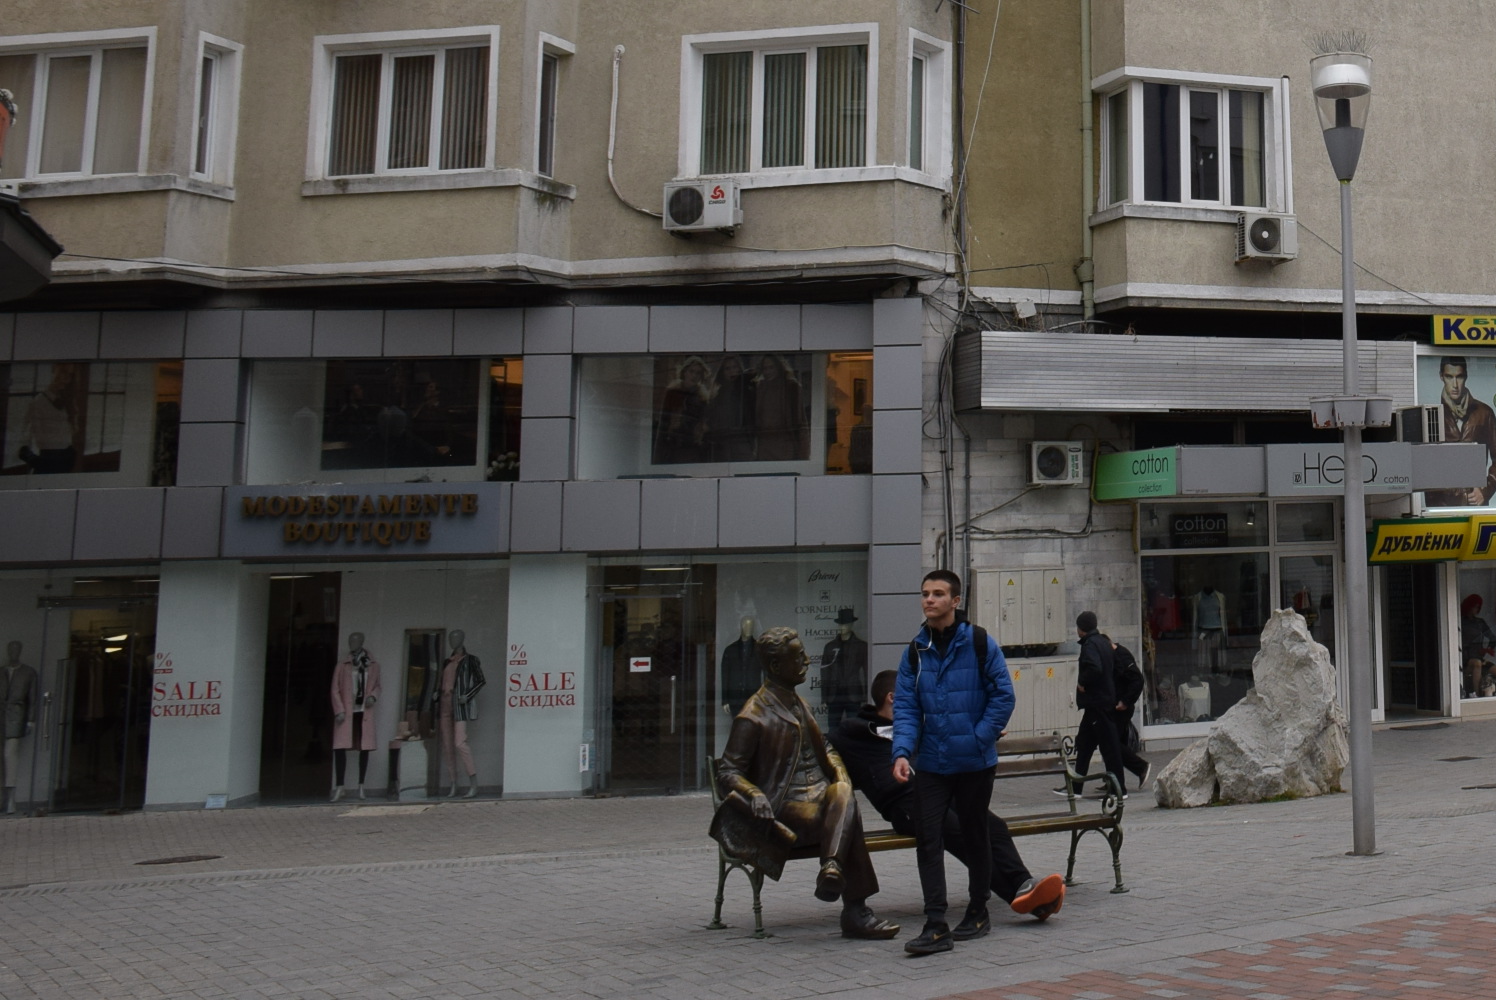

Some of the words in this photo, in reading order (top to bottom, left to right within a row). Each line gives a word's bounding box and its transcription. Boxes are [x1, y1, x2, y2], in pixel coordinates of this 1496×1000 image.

[1132, 454, 1169, 476] cotton
[1384, 475, 1409, 484] cotton
[242, 493, 479, 517] MODESTAMENTE
[283, 520, 432, 546] BOUTIQUE
[1175, 515, 1226, 531] cotton
[1378, 533, 1464, 556] ДУБЛЁНКИ
[153, 680, 222, 701] SALE
[509, 671, 576, 692] SALE
[151, 703, 222, 718] скидка
[508, 693, 576, 709] скидка
